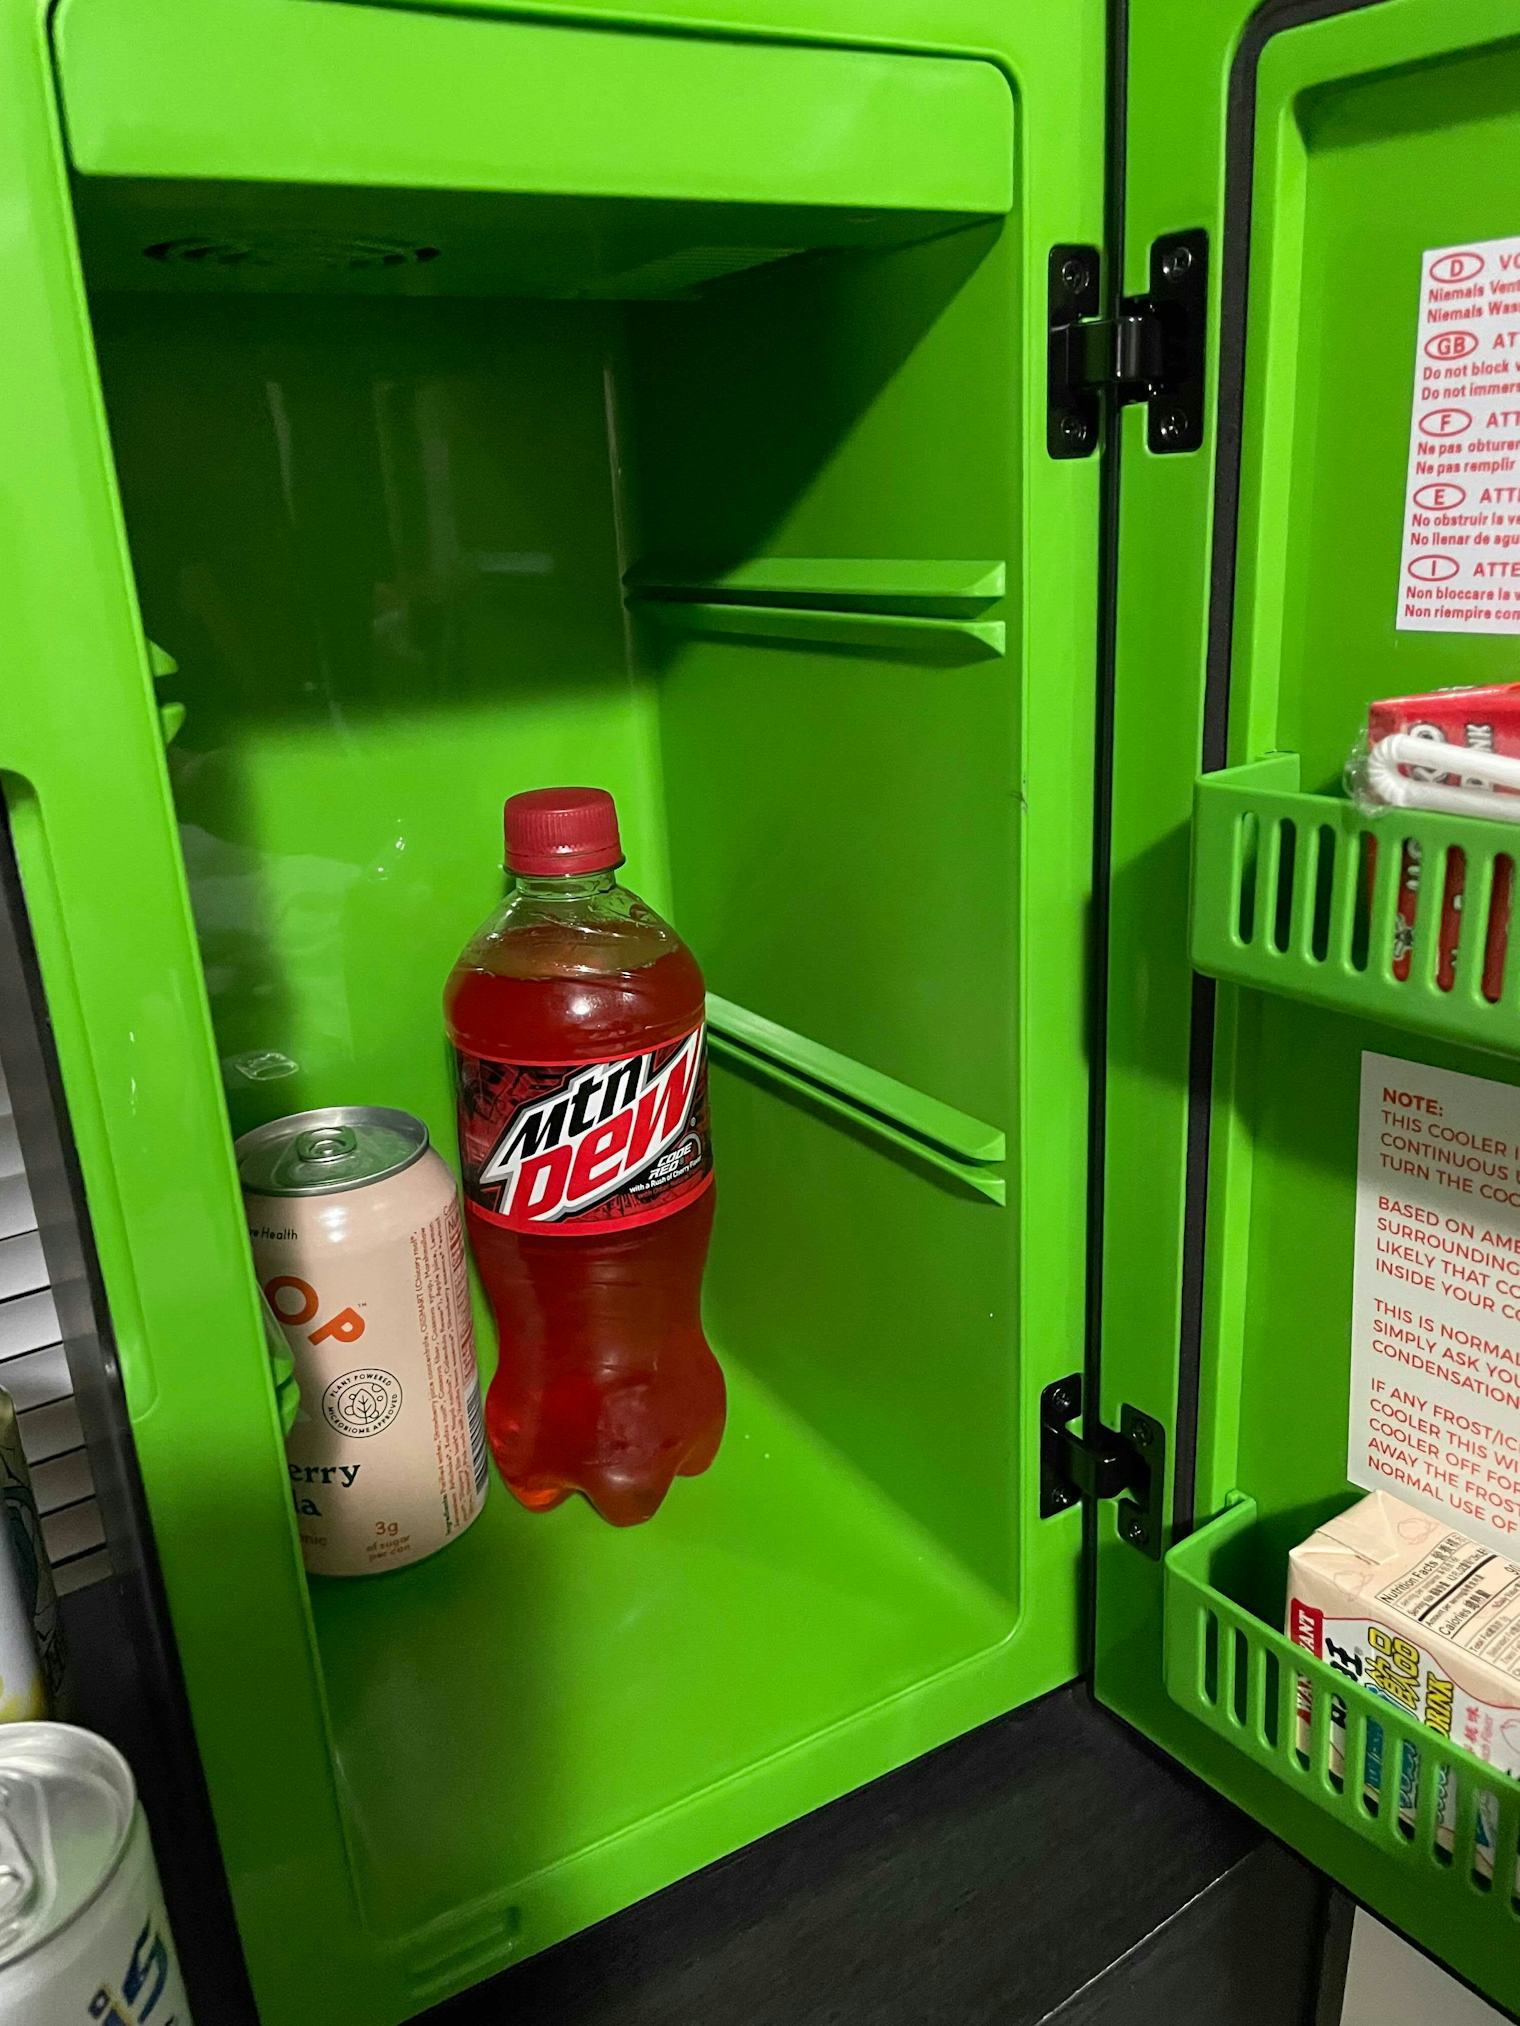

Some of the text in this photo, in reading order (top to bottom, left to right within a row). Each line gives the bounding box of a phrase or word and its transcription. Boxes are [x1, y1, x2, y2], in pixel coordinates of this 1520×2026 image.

[1450, 259, 1464, 278] D
[1429, 284, 1484, 304] Niemals
[1427, 305, 1483, 324] Niemals
[1437, 336, 1466, 356] GB
[1423, 366, 1441, 381] Do
[1445, 365, 1468, 379] not
[1472, 359, 1509, 377] block
[1422, 386, 1440, 401] Do
[1443, 385, 1466, 399] not
[1440, 414, 1452, 432] F
[1417, 442, 1436, 456] Ne
[1439, 442, 1462, 458] pas
[1416, 457, 1516, 477] Ne pas remplir
[1434, 487, 1520, 505] E ATT
[1412, 514, 1430, 527] No
[1434, 512, 1488, 527] obstruir
[1491, 512, 1504, 526] la
[1411, 532, 1428, 546] No
[1432, 532, 1470, 546] llenar
[1474, 531, 1490, 545] de
[1431, 560, 1520, 577] I ATTE
[1406, 586, 1432, 600] Non
[1436, 587, 1494, 601] bloccare
[1498, 587, 1510, 601] la
[1405, 604, 1431, 618] Non
[1434, 605, 1491, 621] riempire
[498, 1054, 643, 1168] Mtn
[1382, 1087, 1444, 1117] NOTE:
[1381, 1109, 1422, 1133] THIS
[1427, 1123, 1507, 1157] COOLER
[657, 1141, 693, 1168] CODE
[1381, 1132, 1509, 1181] CONTINUOUS
[629, 1183, 645, 1193] with
[650, 1176, 667, 1187] Rush
[666, 1173, 673, 1181] of
[672, 1165, 690, 1178] Cherry
[648, 1160, 680, 1180] RED
[1380, 1152, 1430, 1181] TURN
[1435, 1169, 1474, 1194] THE
[1378, 1196, 1440, 1227] BASED
[1444, 1218, 1475, 1240] ON
[262, 1227, 298, 1240] Health
[1376, 1237, 1436, 1269] LIKELY
[1441, 1259, 1491, 1288] THAT
[1376, 1257, 1436, 1291] INSIDE
[1441, 1280, 1496, 1313] YOUR
[1374, 1297, 1413, 1324] THIS
[1419, 1315, 1435, 1333] IS
[1373, 1319, 1437, 1354] SIMPLY
[1442, 1347, 1480, 1373] ASK
[330, 1373, 392, 1397] PLANT POWERED
[1372, 1339, 1520, 1410] CONDENSATION
[1371, 1377, 1386, 1393] IF
[1390, 1387, 1428, 1412] ANY
[328, 1394, 398, 1434] MICROBIOME APPROVED
[1370, 1398, 1441, 1440] COOLER
[1446, 1430, 1488, 1460] THIS
[1369, 1418, 1440, 1459] COOLER
[1446, 1452, 1481, 1476] OFF
[288, 1464, 361, 1488] erry
[1368, 1438, 1418, 1468] AWAY
[1424, 1461, 1459, 1488] THE
[1368, 1455, 1518, 1534] NORMAL USE OF
[375, 1521, 398, 1536] 3g
[1380, 1576, 1420, 1603] Nutrition
[1412, 1560, 1439, 1580] Facts
[1298, 1609, 1315, 1654] ANT
[1438, 1607, 1472, 1636] Calories
